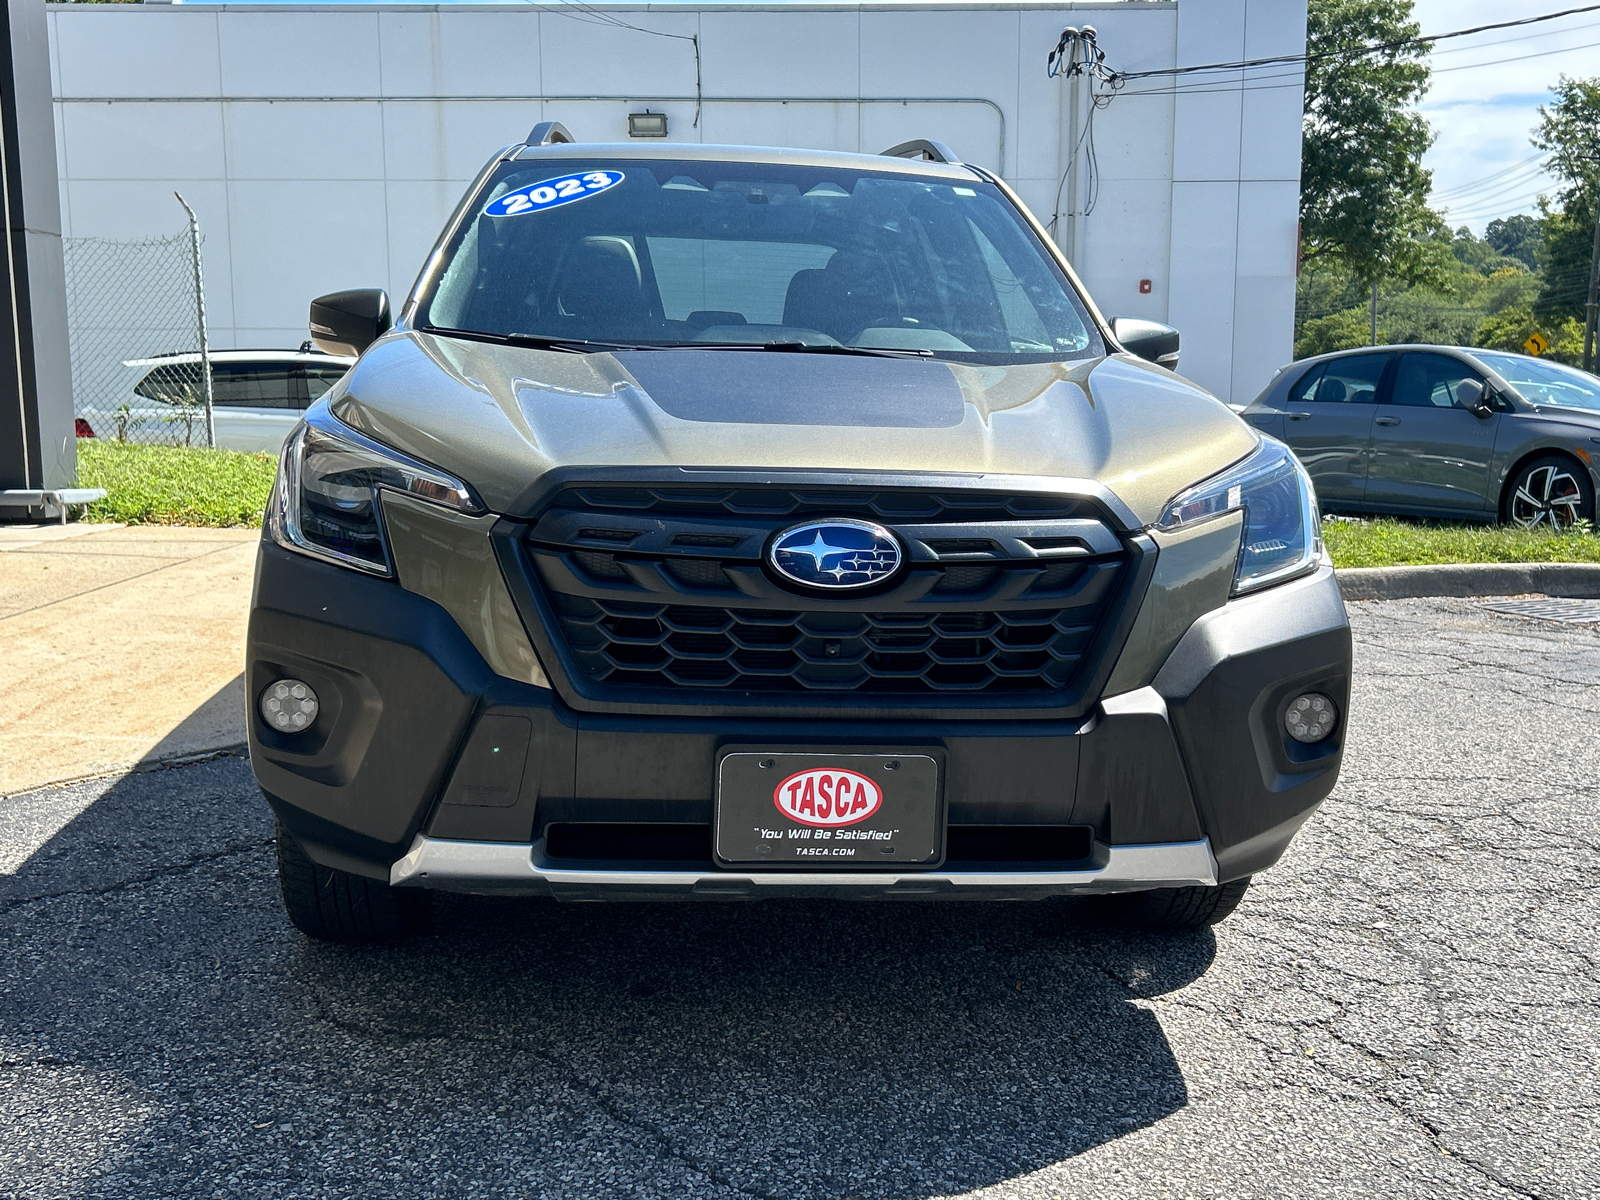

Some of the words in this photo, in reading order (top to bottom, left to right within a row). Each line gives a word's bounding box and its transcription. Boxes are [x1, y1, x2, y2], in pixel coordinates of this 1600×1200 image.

[502, 172, 612, 214] 2023
[787, 774, 868, 819] TASCA
[753, 827, 784, 840] "You
[788, 828, 811, 840] Will
[813, 829, 832, 840] Be
[834, 829, 900, 841] Satisfied"
[795, 847, 856, 856] TASCA.COM
